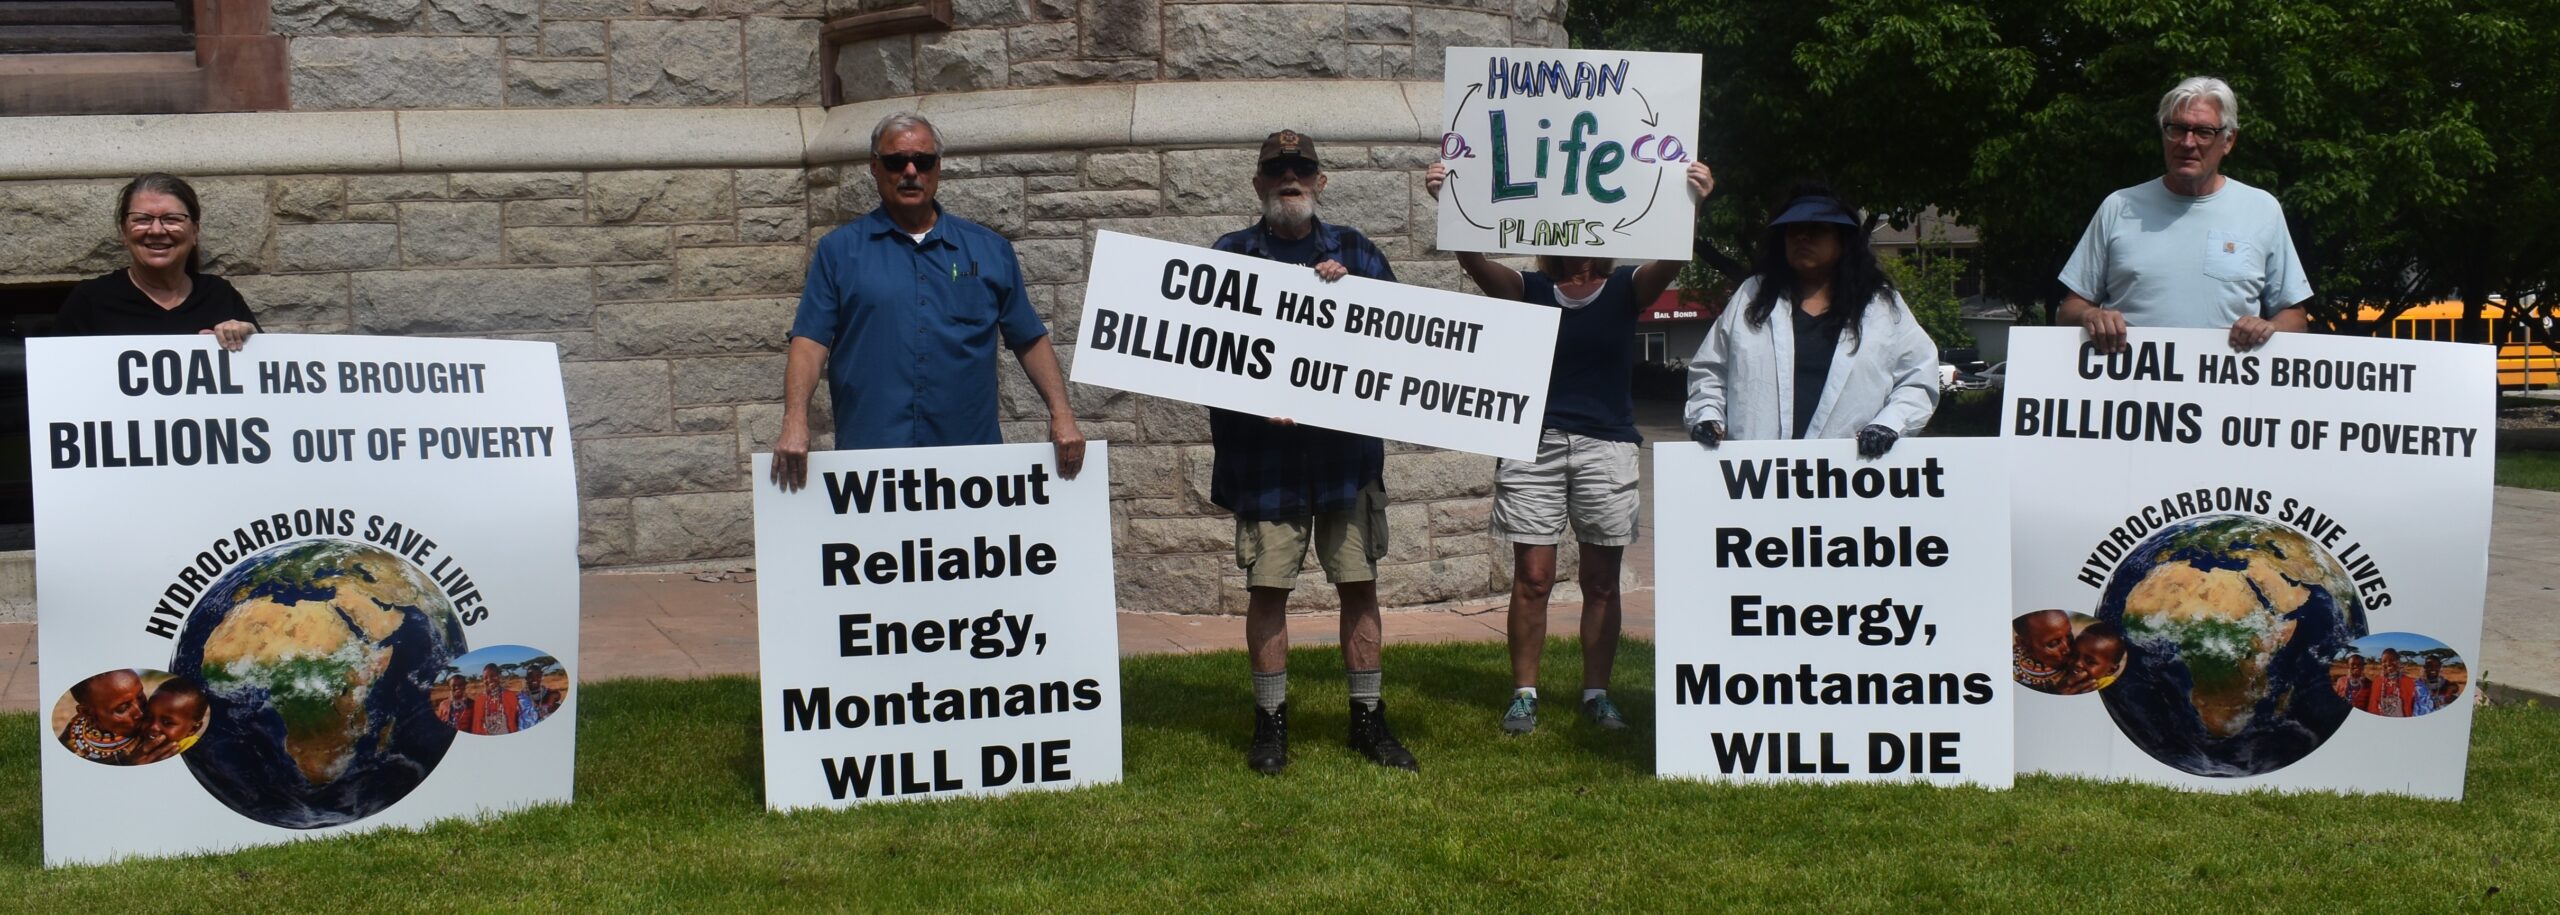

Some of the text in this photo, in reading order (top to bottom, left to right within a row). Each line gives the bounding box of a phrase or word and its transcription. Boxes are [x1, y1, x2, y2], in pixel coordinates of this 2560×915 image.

[1487, 56, 1630, 100] HUMAN
[1488, 109, 1627, 203] Life
[1499, 217, 1605, 248] PLANTS
[1160, 258, 1484, 353] COAL HAS BROUGHT
[1653, 310, 1698, 319] BAIL BONDS
[117, 349, 487, 396] COAL HAS BROUGHT
[1090, 308, 1530, 425] BILLIONS OUT OF POVERTY
[2078, 340, 2417, 393] COAL HAS BROUGHT
[49, 417, 554, 469] BILLIONS OUT OF POVERTY
[2015, 397, 2478, 458] BILLIONS OUT OF POVERTY
[823, 463, 1049, 514] Without
[1719, 457, 1945, 500] Without
[821, 534, 1057, 586] Reliable
[1715, 525, 1949, 568] Reliable
[2077, 486, 2392, 612] HYDROCARBONS SAVE LIVES
[145, 508, 489, 640] HYDROCARBONS SAVE LIVES
[839, 609, 1048, 659] Energy,
[1730, 595, 1937, 646] Energy,
[783, 678, 1102, 732] Montanans
[1675, 664, 1994, 706] Montanans
[822, 739, 1071, 800] WILL DIE
[1710, 732, 1961, 774] WILL DIE
